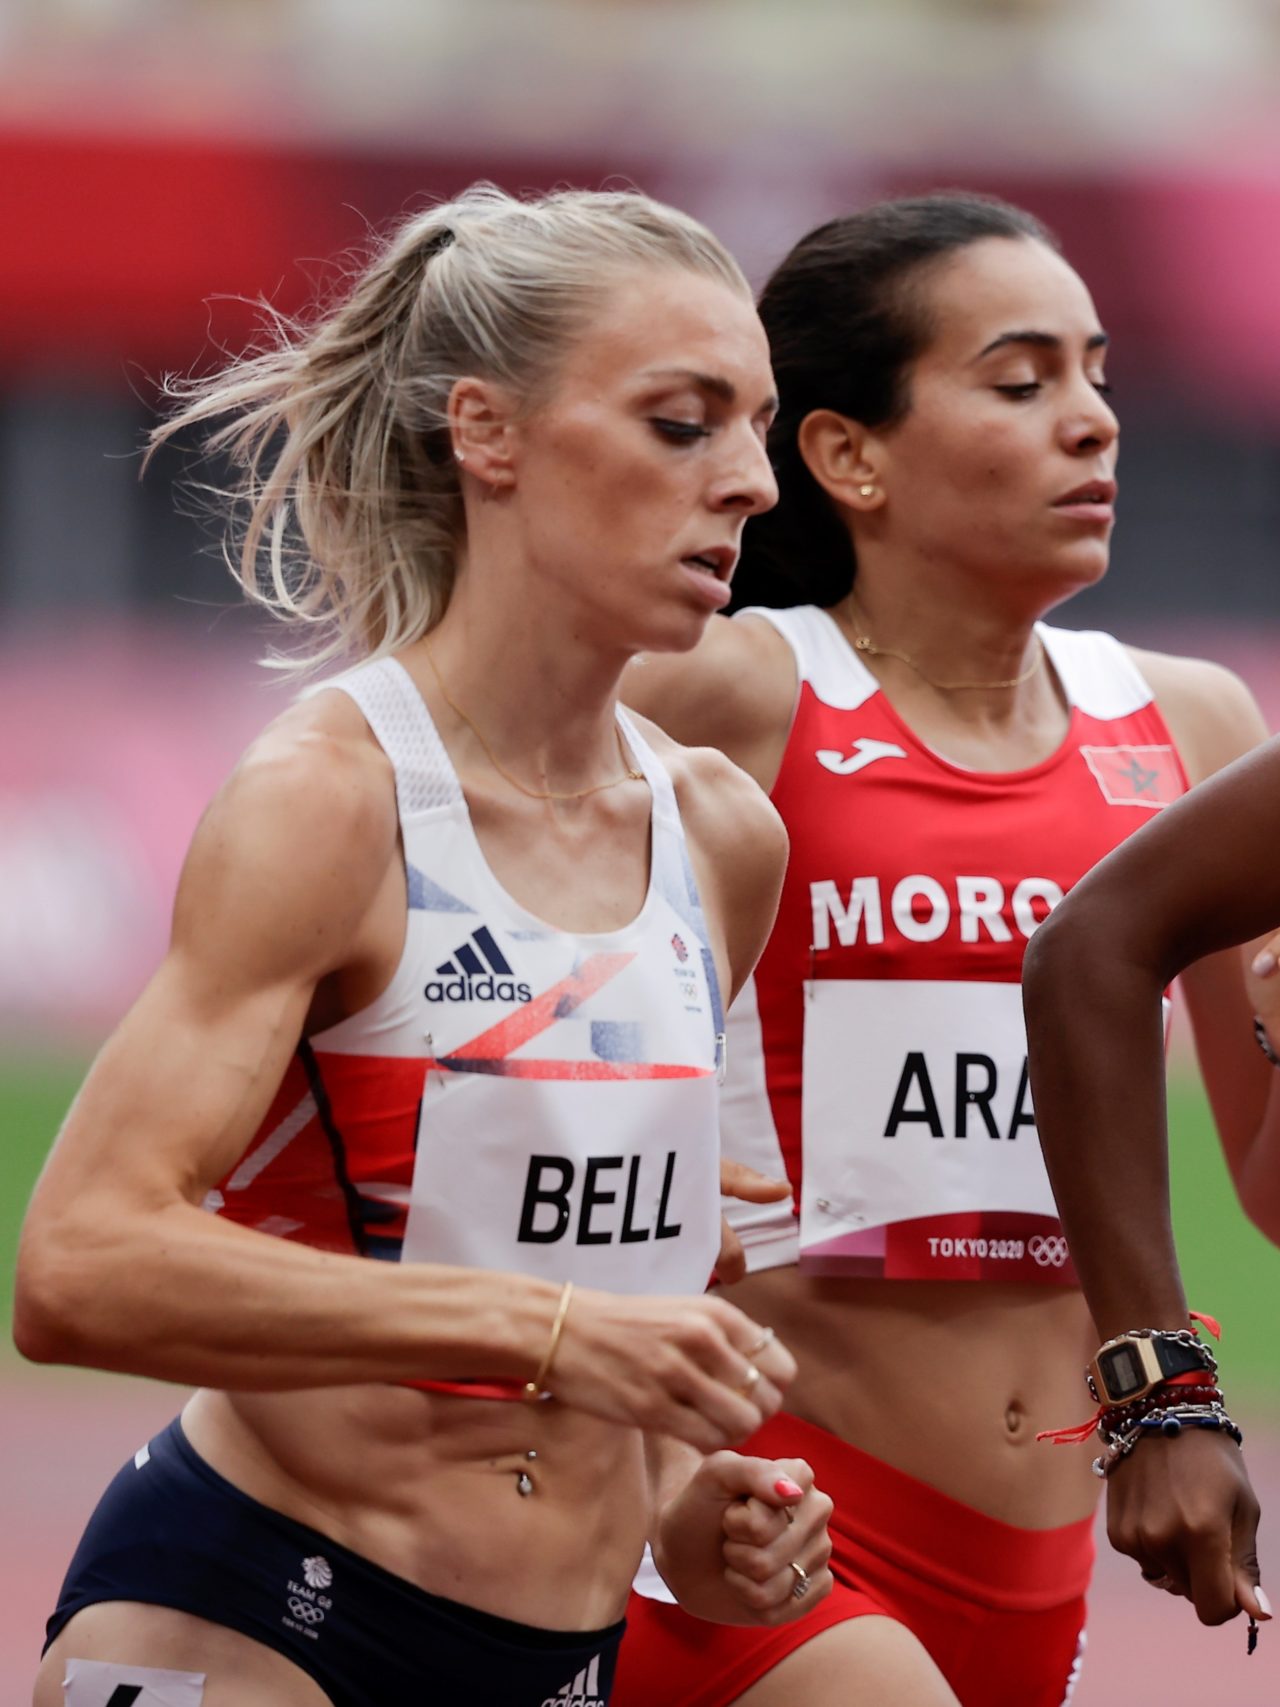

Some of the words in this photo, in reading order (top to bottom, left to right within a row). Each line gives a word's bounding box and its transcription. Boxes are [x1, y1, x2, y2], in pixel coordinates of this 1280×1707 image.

[424, 975, 532, 1003] adidas
[517, 1151, 682, 1245] BELL
[928, 1237, 988, 1258] TOKYO
[988, 1239, 1025, 1260] 2020
